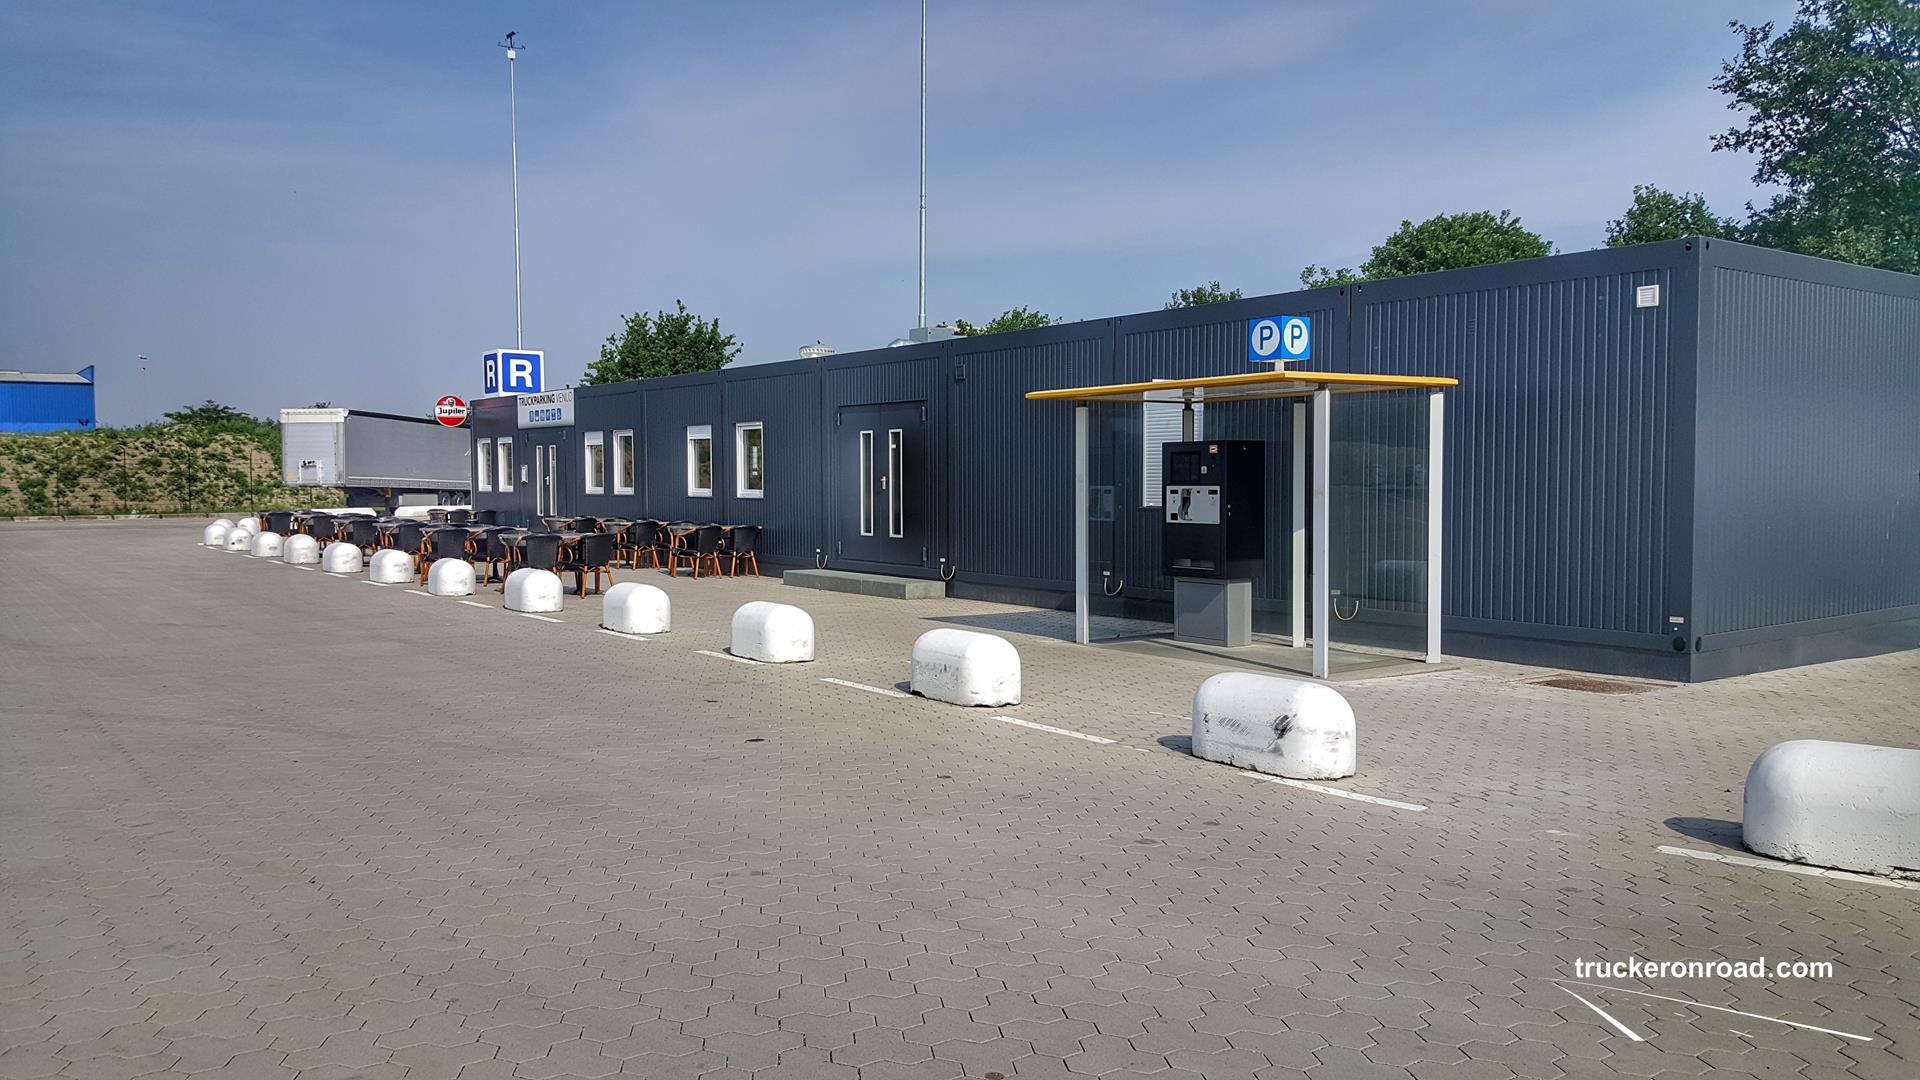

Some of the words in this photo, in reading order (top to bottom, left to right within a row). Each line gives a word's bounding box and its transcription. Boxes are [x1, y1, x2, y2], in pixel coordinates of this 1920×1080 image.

[1260, 326, 1274, 350] P
[1291, 324, 1303, 348] P
[486, 360, 496, 388] R
[509, 358, 533, 388] R
[519, 393, 555, 406] TRUCKPARKING
[556, 391, 572, 403] VENLO
[437, 407, 465, 415] Jupiler
